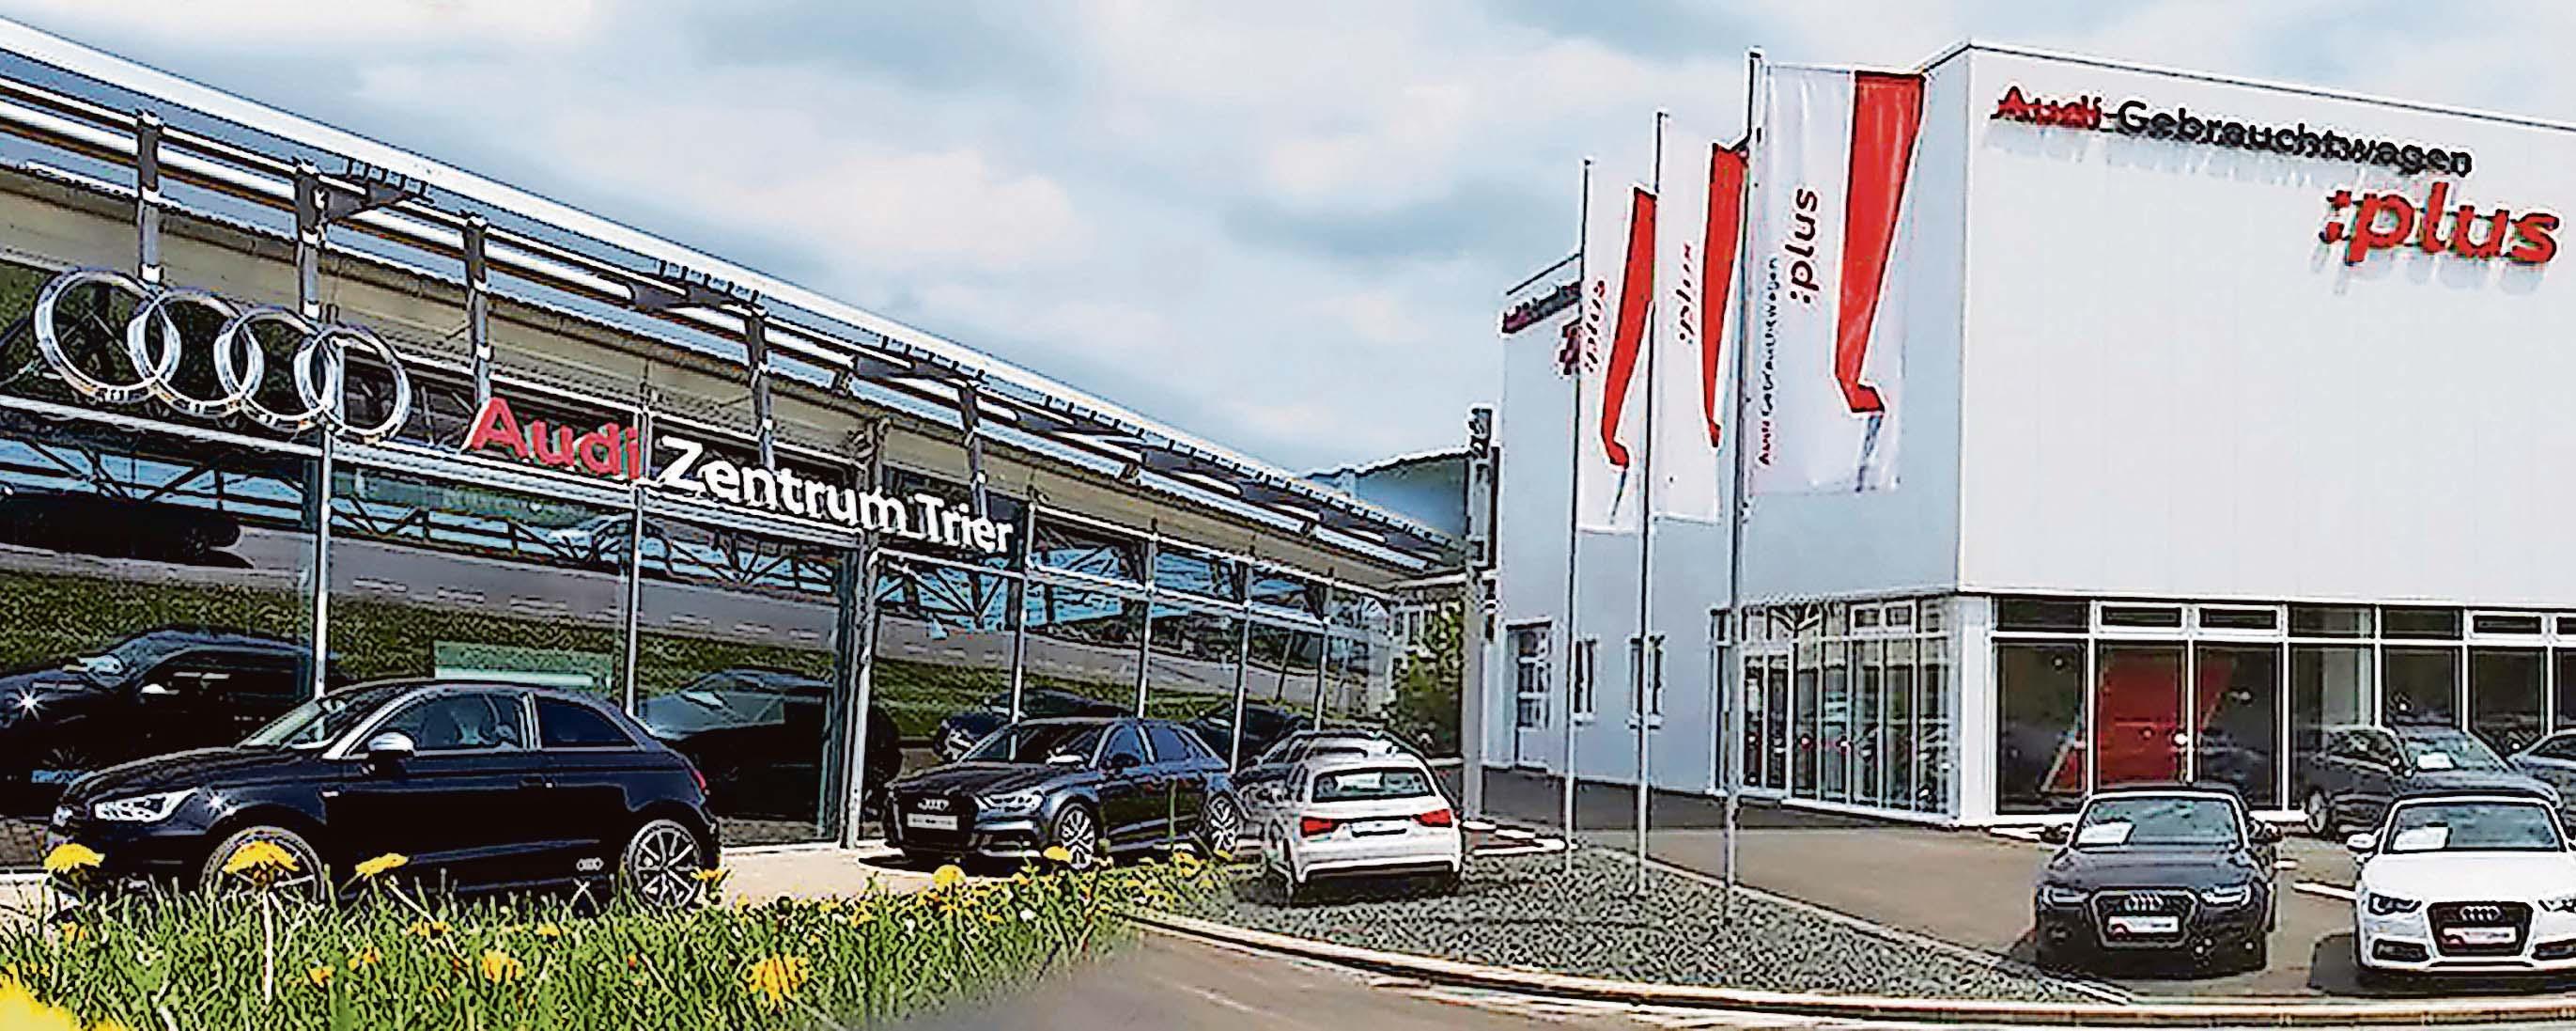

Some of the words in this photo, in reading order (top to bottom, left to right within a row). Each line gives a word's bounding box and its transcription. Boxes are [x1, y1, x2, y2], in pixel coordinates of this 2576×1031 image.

[1991, 86, 2103, 131] Audi
[2117, 100, 2473, 179] Gebrauchtwagen
[1784, 188, 1820, 305] :plus
[2320, 182, 2561, 267] :plus
[473, 398, 643, 481] Audi
[657, 436, 908, 534] Zentrum
[912, 492, 1014, 554] Trier
